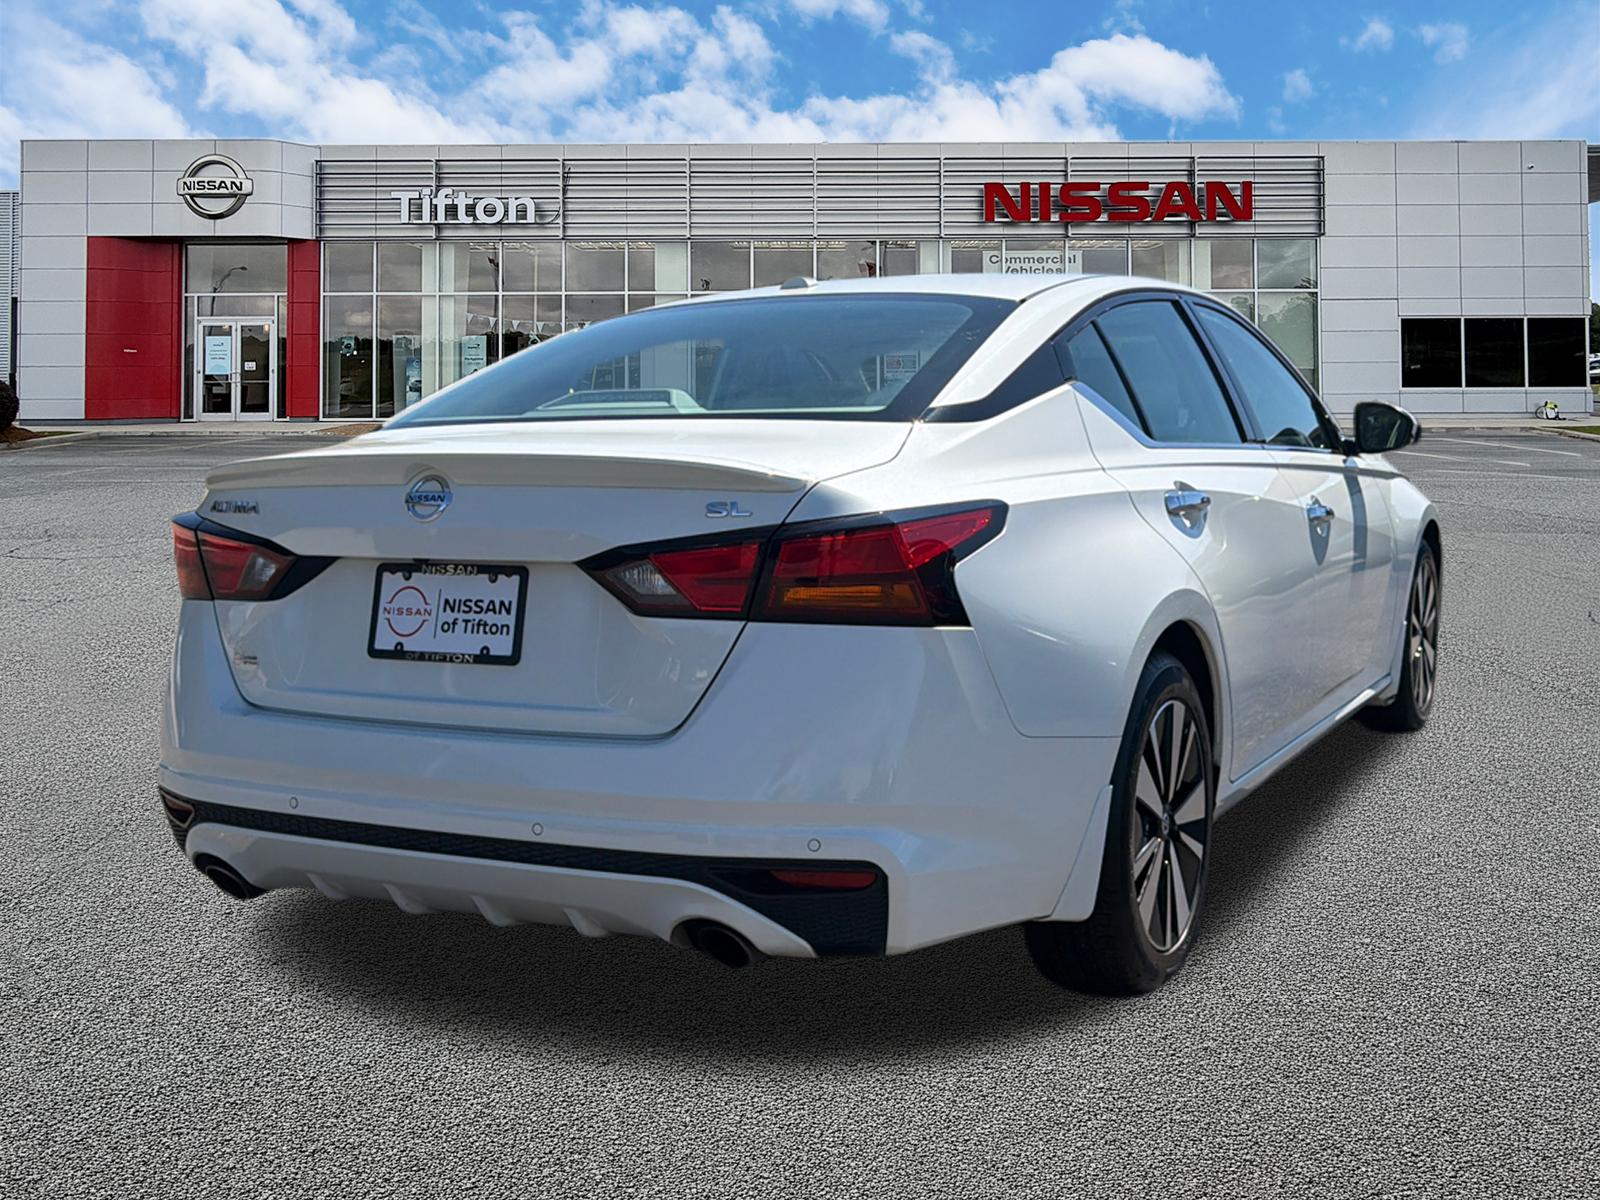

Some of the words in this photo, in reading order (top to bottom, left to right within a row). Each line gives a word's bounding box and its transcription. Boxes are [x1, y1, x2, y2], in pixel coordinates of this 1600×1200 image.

[183, 180, 243, 192] NISSAN
[391, 188, 536, 224] Tifton
[984, 180, 1254, 222] NISSAN
[409, 494, 446, 502] NISSAN
[705, 501, 753, 518] SL
[421, 564, 478, 576] NISSAN
[383, 606, 432, 617] NISSAN
[442, 598, 512, 616] NISSAN
[440, 618, 458, 634] of
[462, 618, 510, 637] Tifton
